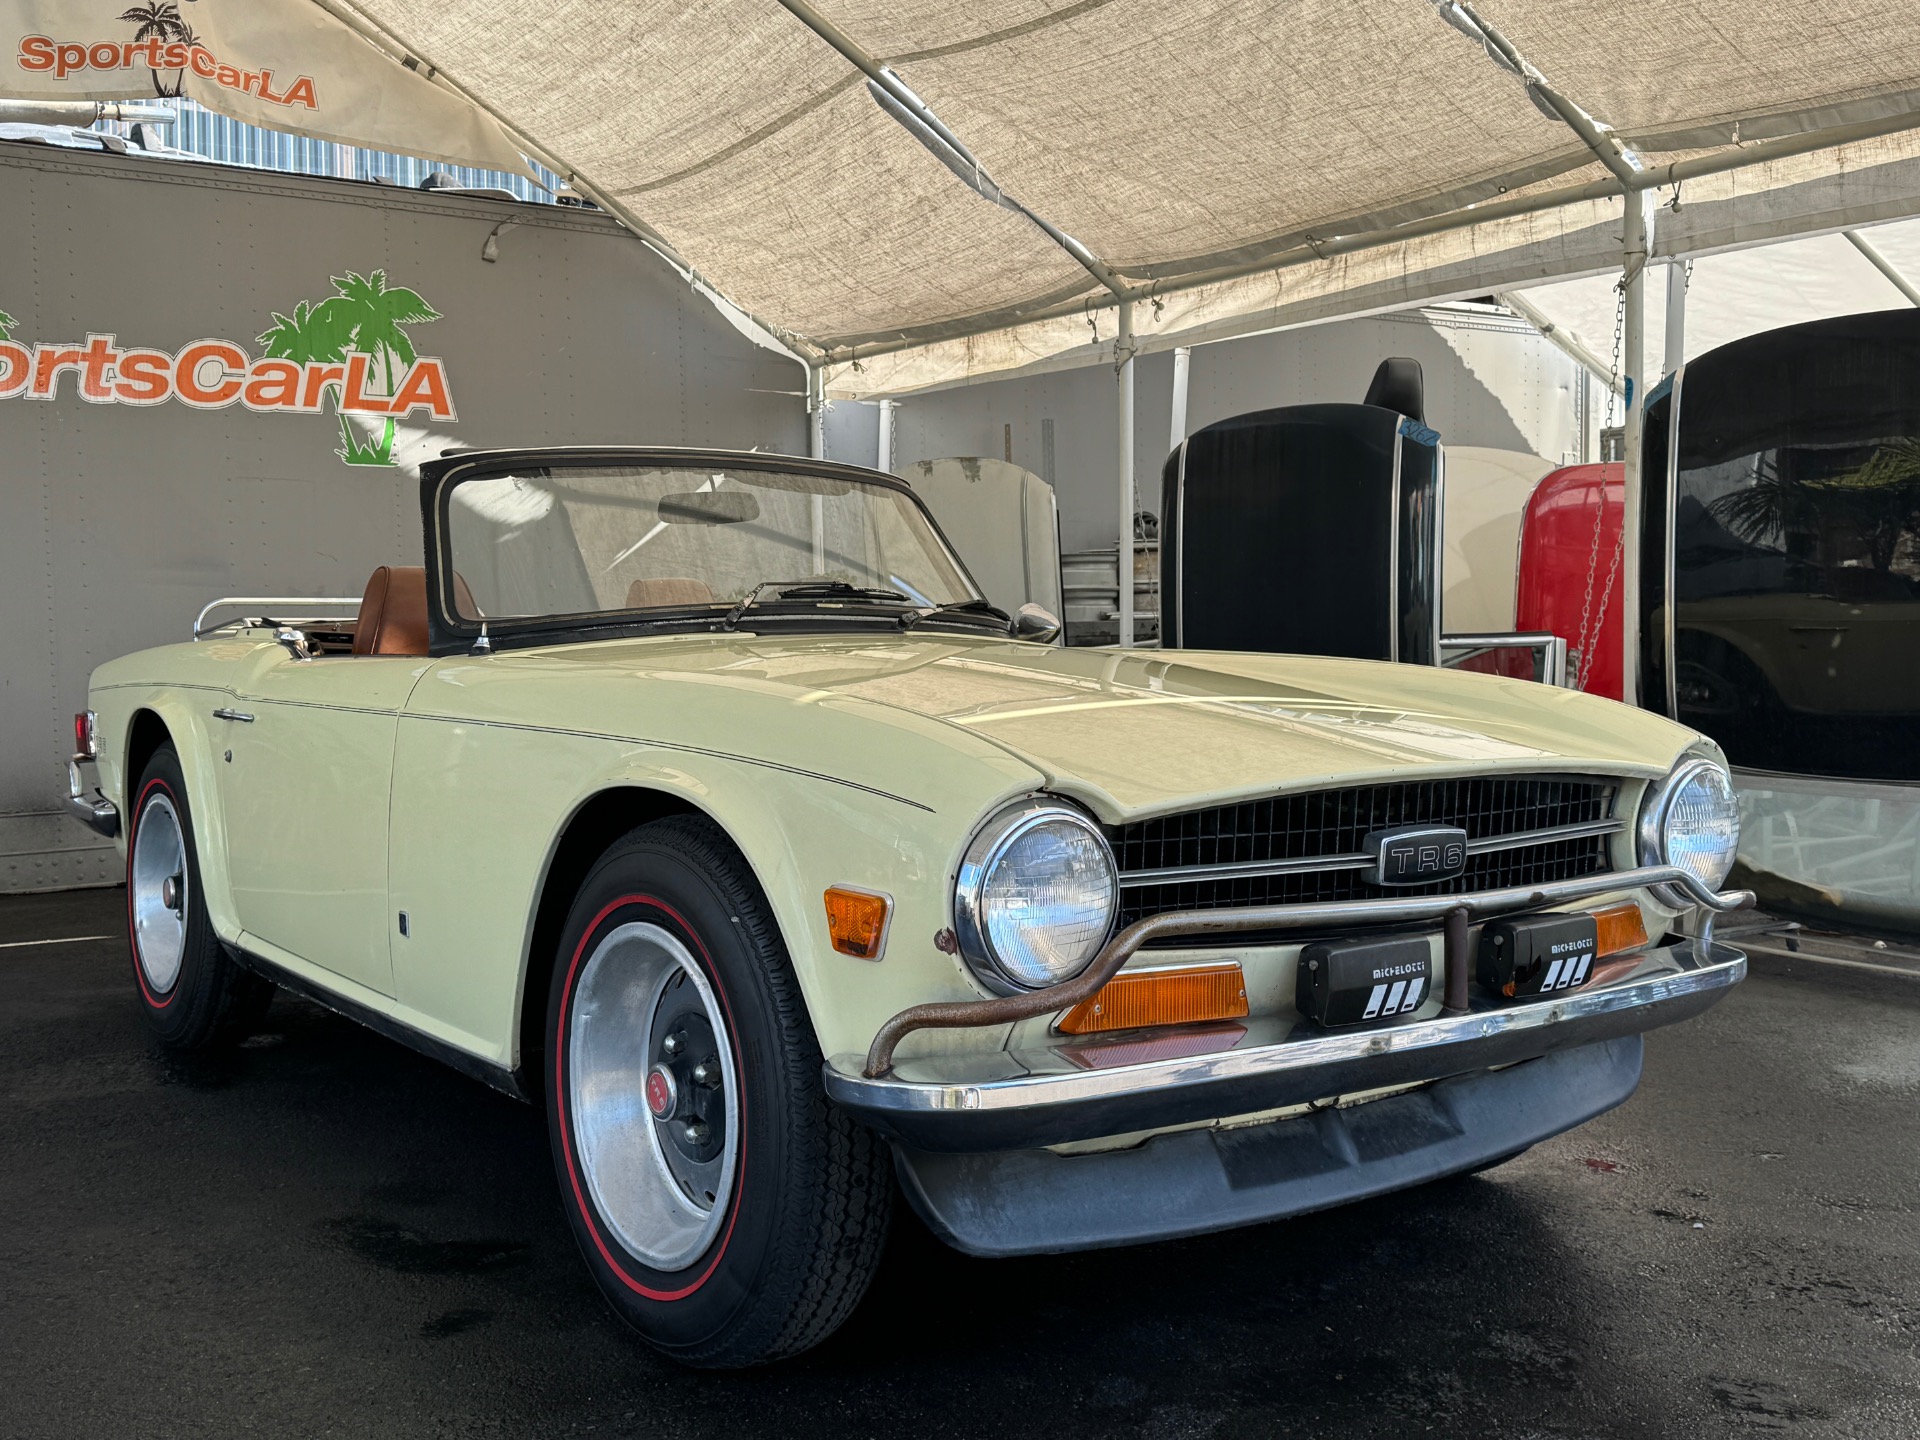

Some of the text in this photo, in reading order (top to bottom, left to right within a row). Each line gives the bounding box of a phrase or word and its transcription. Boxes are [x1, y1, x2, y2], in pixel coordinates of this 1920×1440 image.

[18, 35, 318, 110] SportsCarLA
[1402, 420, 1437, 444] 3262
[1391, 843, 1463, 874] TR6
